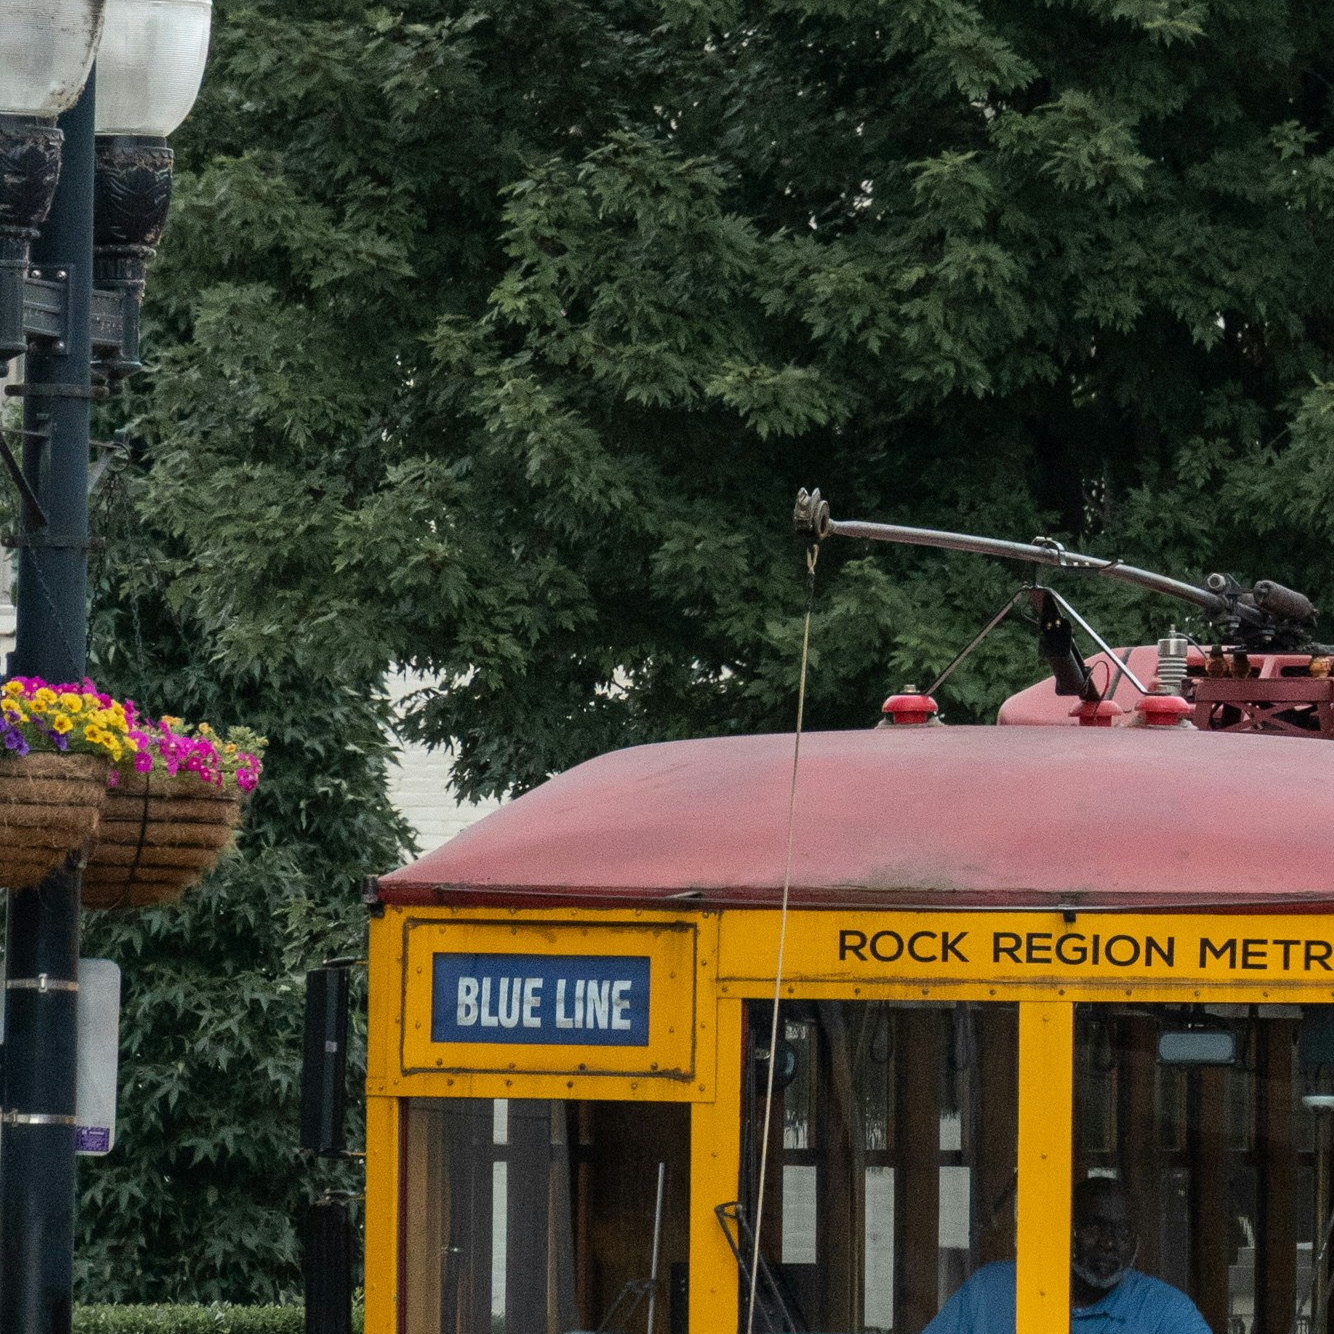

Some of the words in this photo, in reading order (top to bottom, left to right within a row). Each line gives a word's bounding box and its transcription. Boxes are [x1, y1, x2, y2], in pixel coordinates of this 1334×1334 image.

[838, 929, 970, 963] ROCK
[992, 932, 1175, 967] REGION
[457, 977, 543, 1028] BLUE
[555, 978, 632, 1030] LINE
